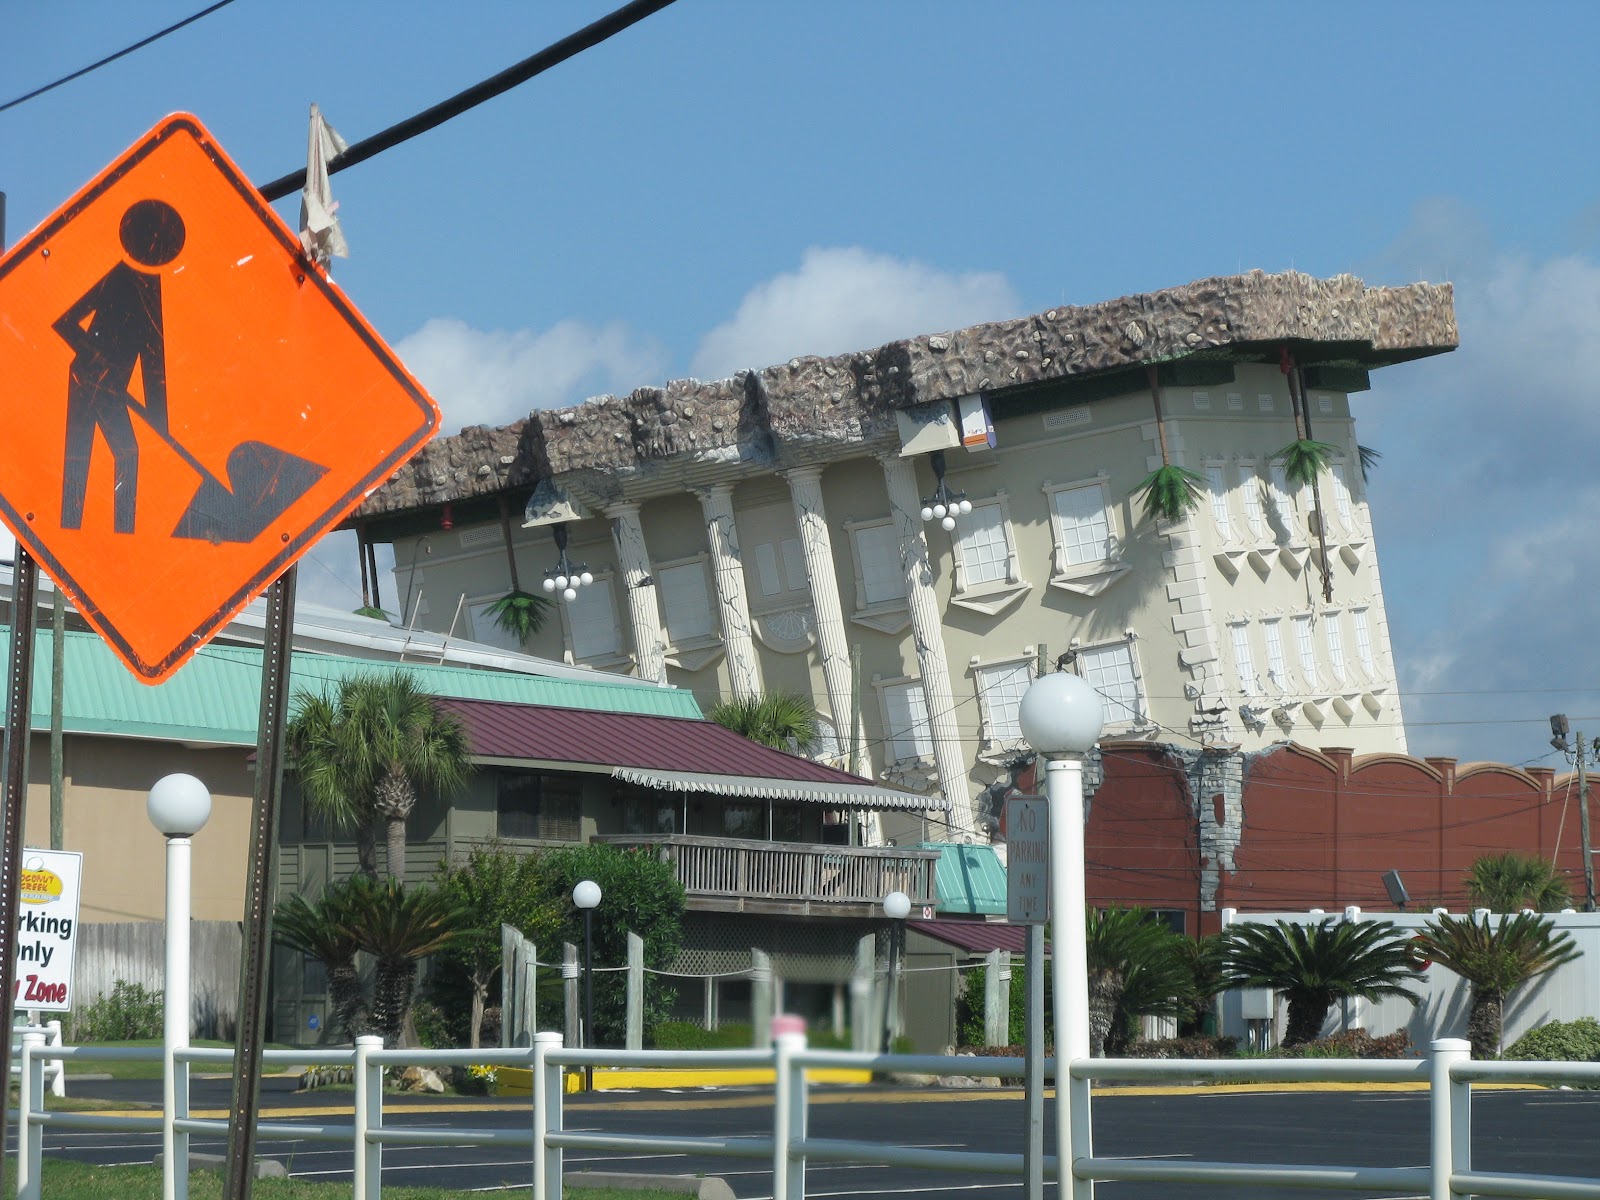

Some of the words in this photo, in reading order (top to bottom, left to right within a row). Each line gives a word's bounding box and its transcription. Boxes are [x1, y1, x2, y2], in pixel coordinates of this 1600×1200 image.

[1020, 809, 1036, 832] NO
[1010, 841, 1046, 863] PARKING
[20, 874, 54, 884] OCONUT
[1020, 874, 1036, 888] ANY
[1019, 896, 1037, 912] TIME
[18, 911, 72, 940] rking
[17, 940, 54, 967] nly
[25, 974, 67, 1003] Zone
